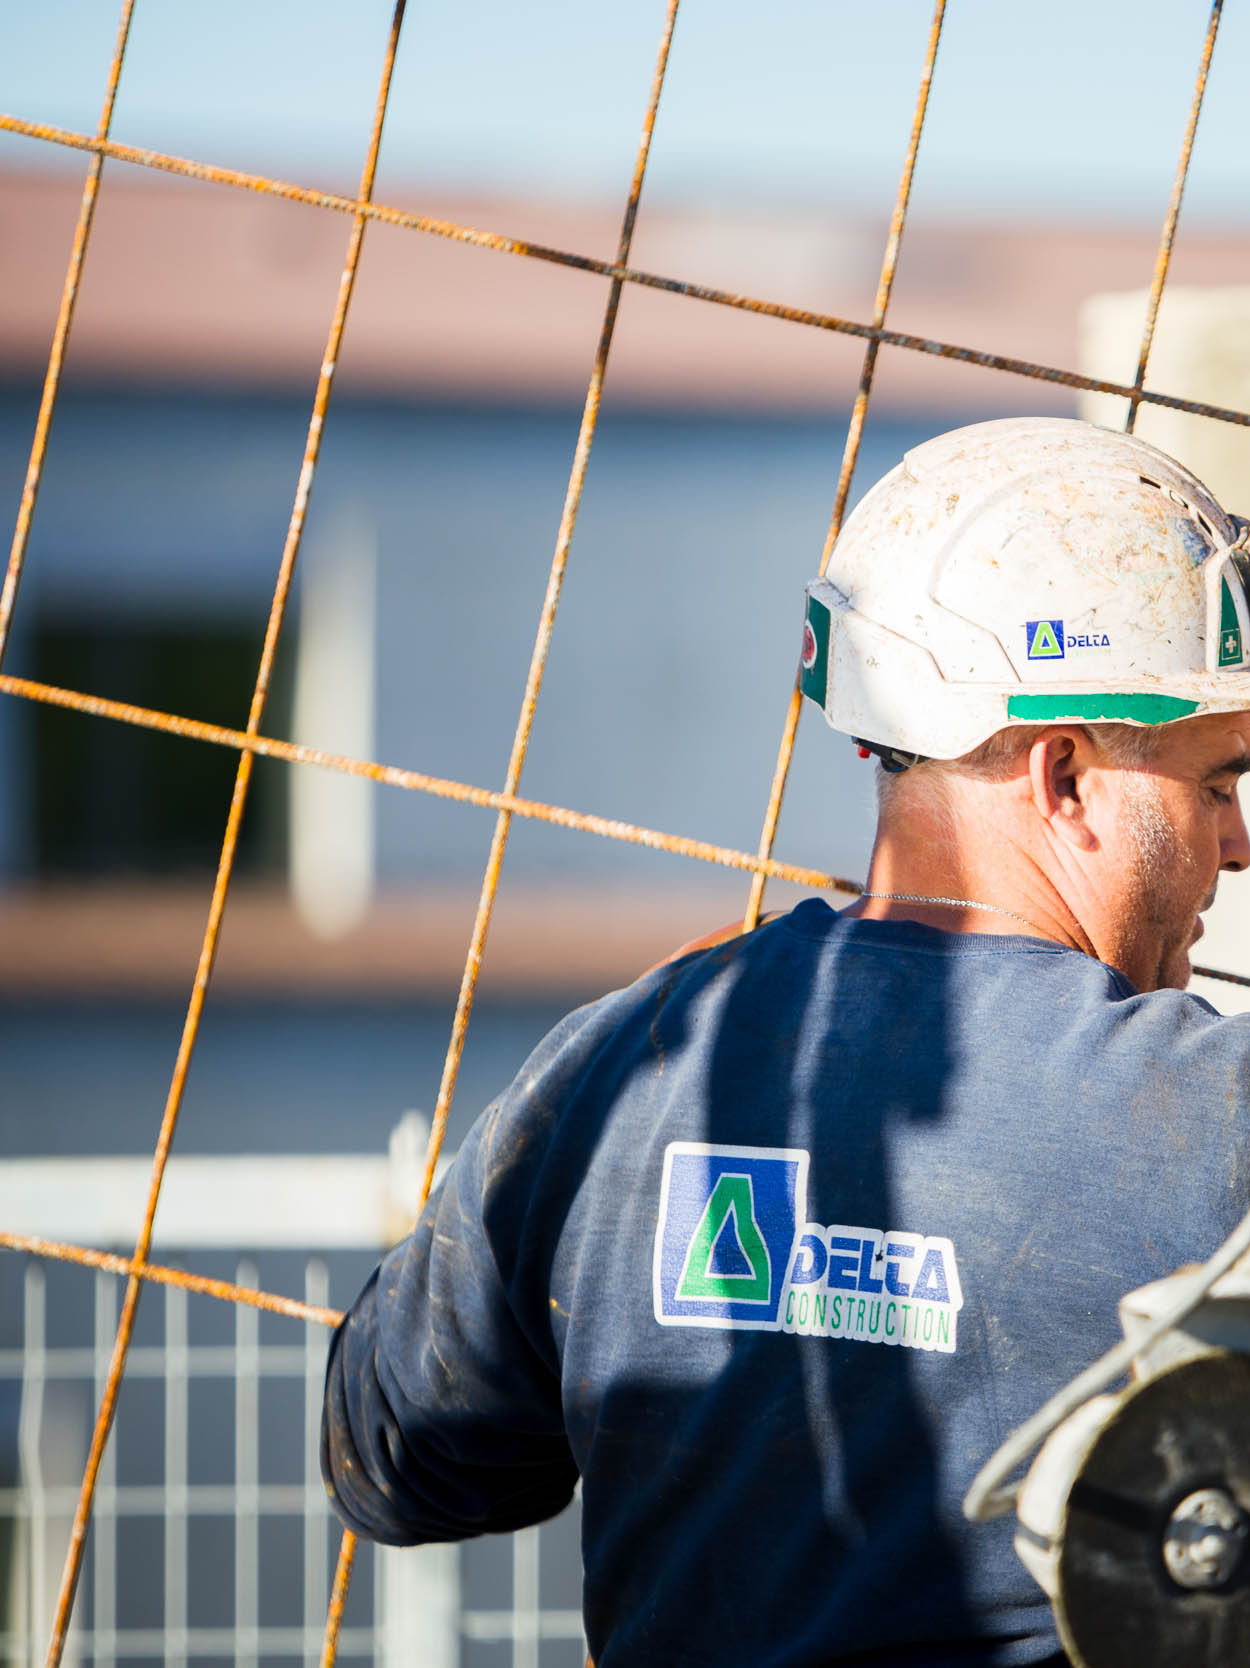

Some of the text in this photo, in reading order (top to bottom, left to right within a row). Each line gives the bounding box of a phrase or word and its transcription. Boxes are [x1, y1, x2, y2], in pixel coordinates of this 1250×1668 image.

[1067, 635, 1110, 648] DELTA
[791, 1234, 950, 1302] DELTA
[785, 1290, 950, 1344] CONSTRUCTION
